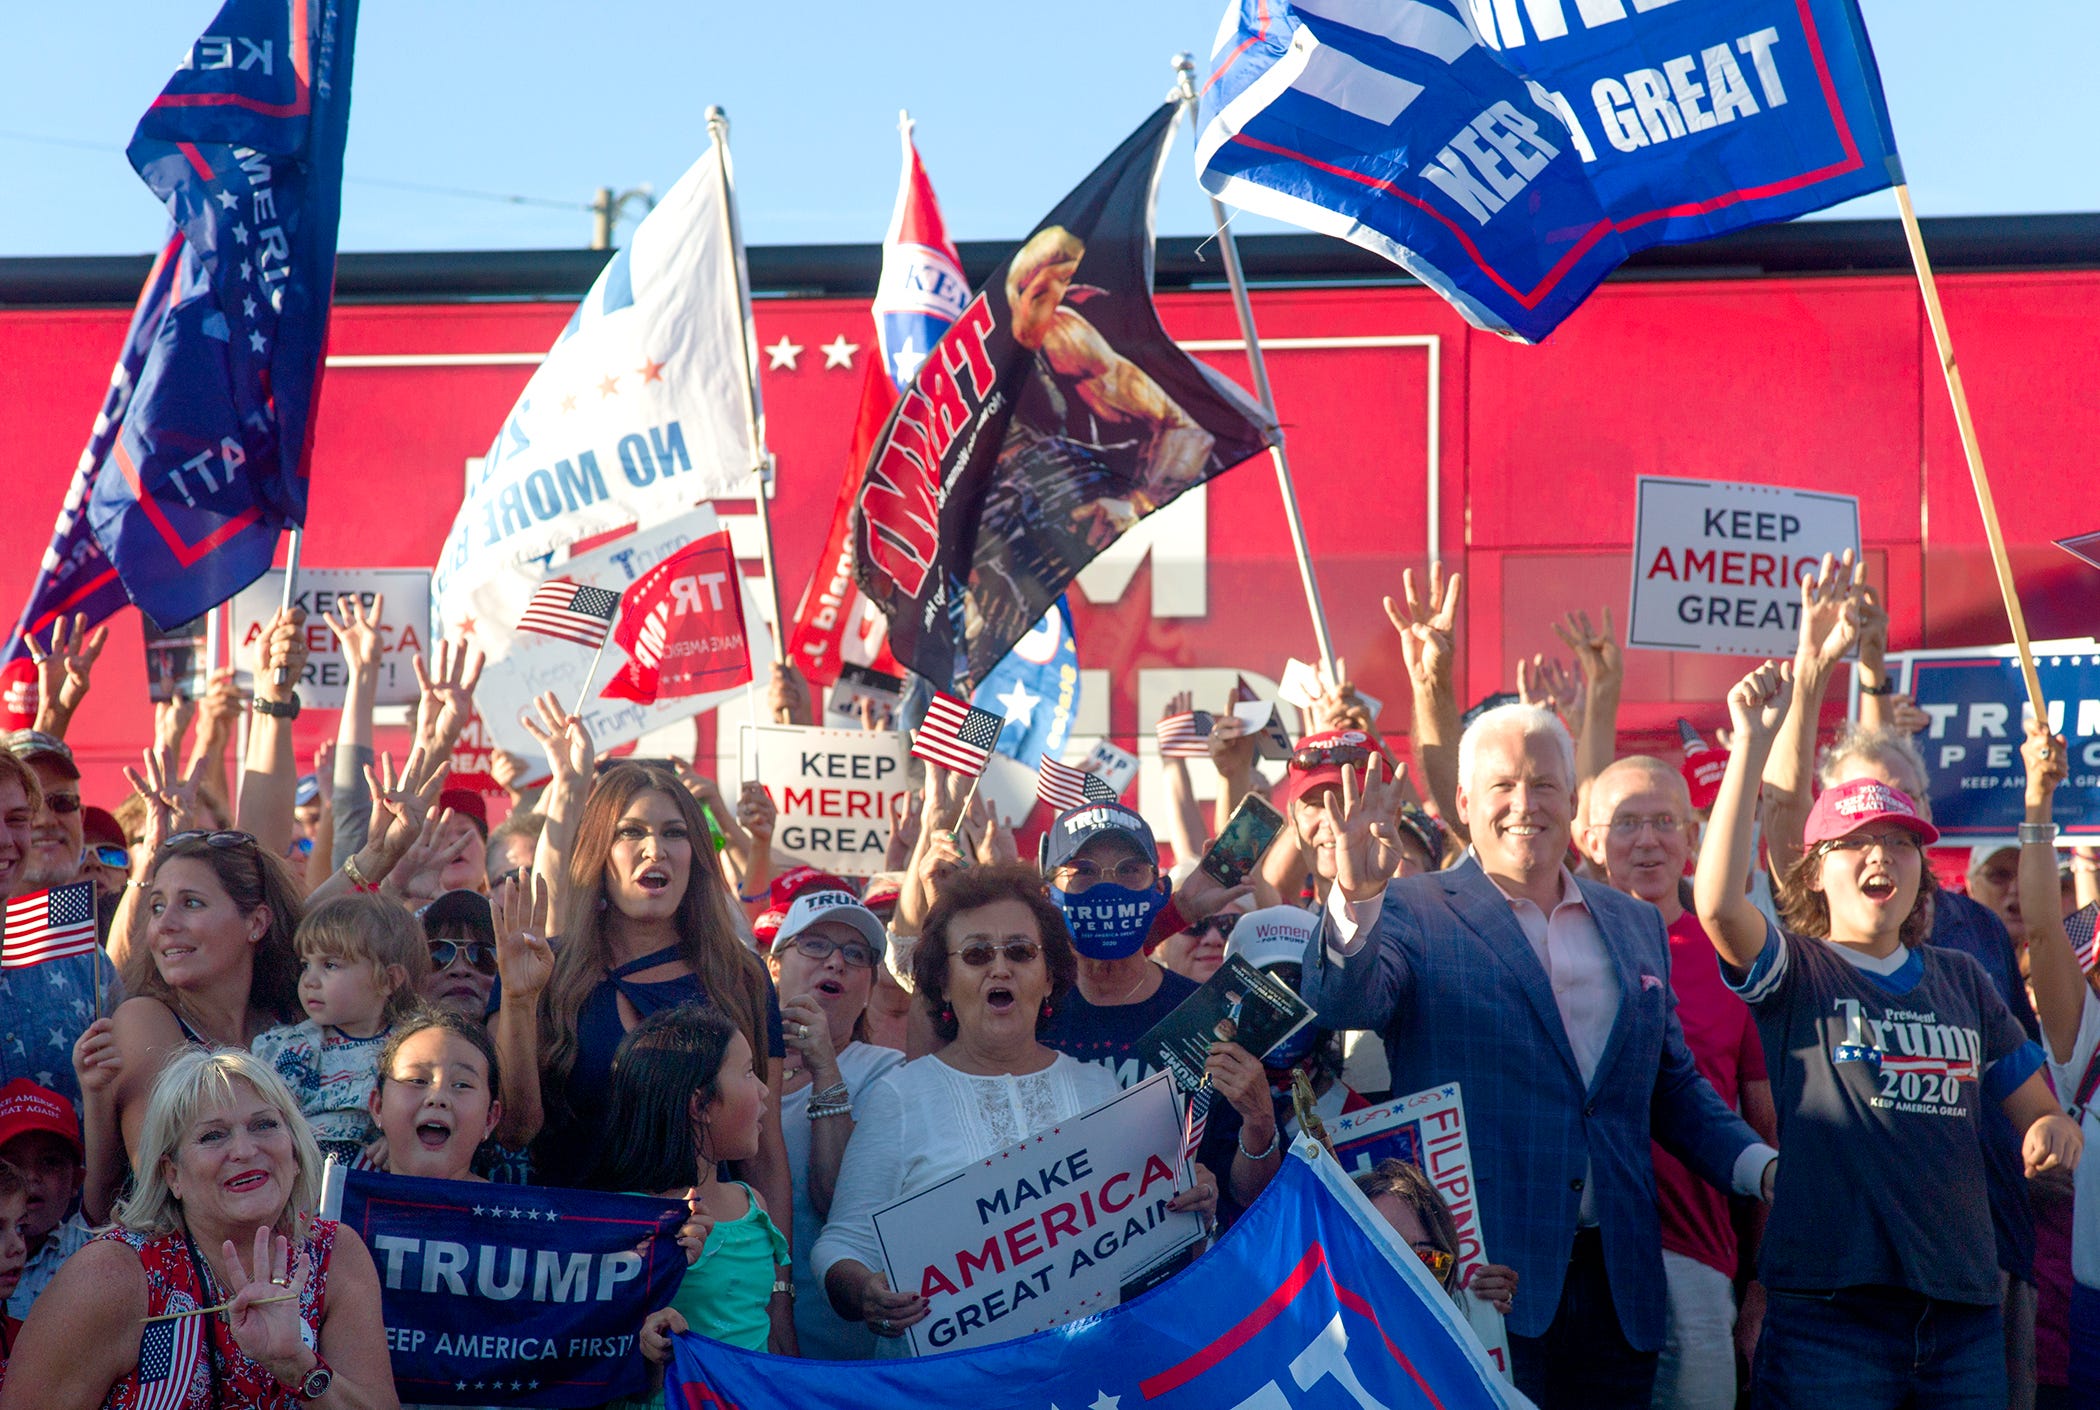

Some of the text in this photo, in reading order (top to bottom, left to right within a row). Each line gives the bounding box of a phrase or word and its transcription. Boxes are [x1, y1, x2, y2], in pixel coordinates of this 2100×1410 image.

[1591, 26, 1788, 152] GREAT
[1418, 99, 1560, 226] KEEP
[1704, 508, 1801, 543] KEEP
[1647, 547, 1851, 591] AMERIC
[801, 752, 896, 780] KEEP
[1960, 776, 1999, 790] KEEP
[1064, 806, 1142, 835] TRUMP
[782, 827, 891, 854] GREA
[805, 894, 866, 909] TRU
[1063, 901, 1150, 920] TRUMP
[1073, 917, 1143, 931] PENCE
[1256, 924, 1311, 940] Women
[1262, 935, 1305, 944] FOR TRUMP
[1885, 1008, 1936, 1024] President
[1833, 997, 1981, 1078] Trump
[1879, 1070, 1960, 1105] 2020
[0, 1105, 60, 1119] EAT AGAIN
[15, 1094, 61, 1113] AMERICA
[1870, 1096, 1967, 1118] KEEP AMERICA GREAT
[975, 1148, 1093, 1226] MAKE
[920, 1153, 1174, 1298] AMERICA
[374, 1233, 642, 1303] TRUMP
[927, 1264, 1055, 1348] GREAT
[384, 1326, 634, 1361] EEP AMERICA FIRST!
